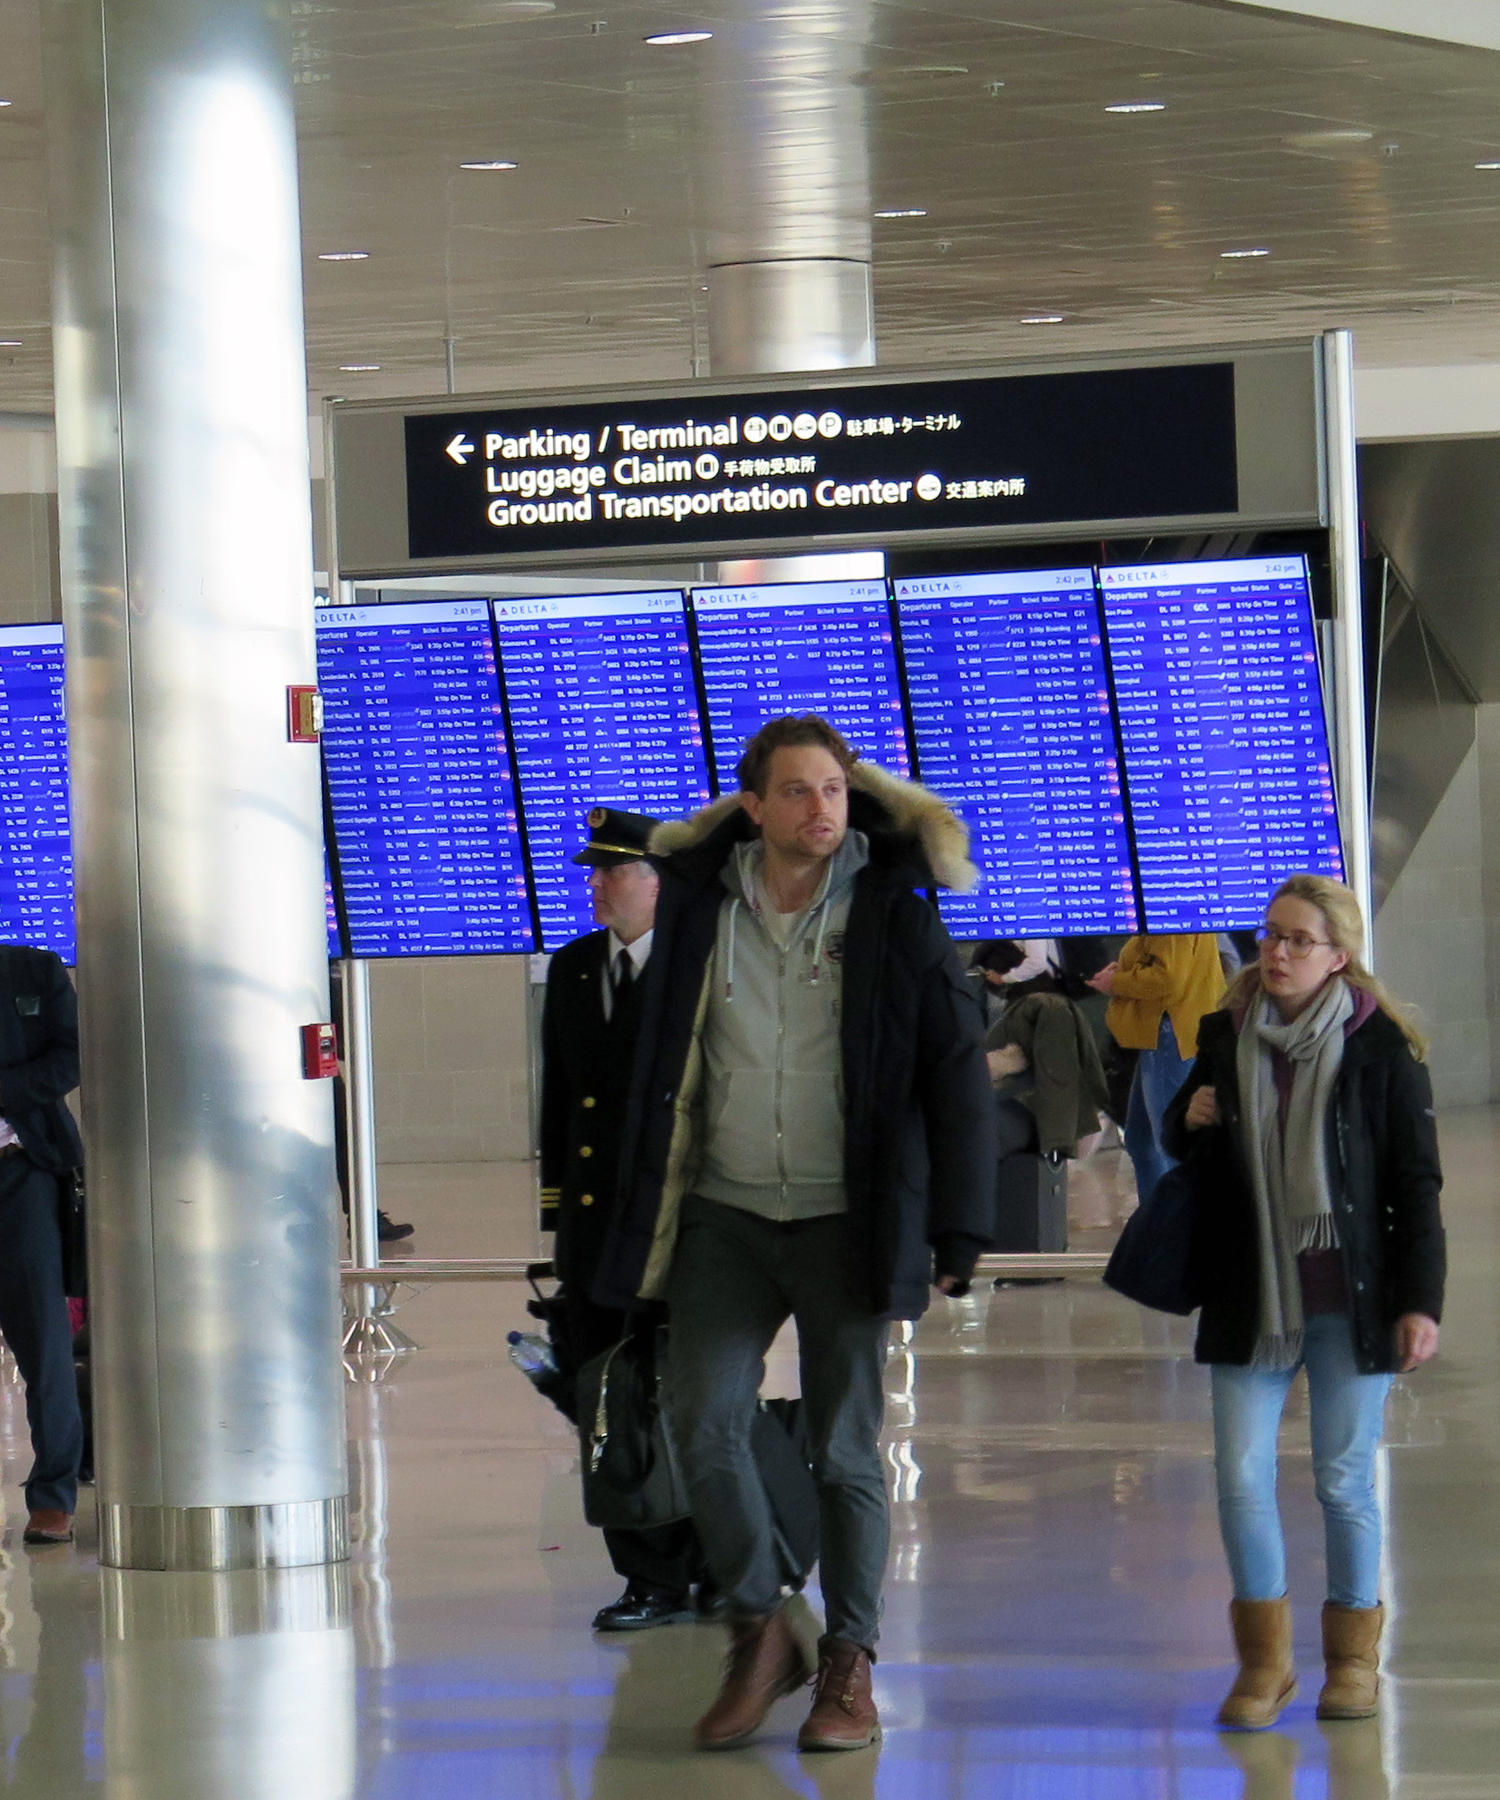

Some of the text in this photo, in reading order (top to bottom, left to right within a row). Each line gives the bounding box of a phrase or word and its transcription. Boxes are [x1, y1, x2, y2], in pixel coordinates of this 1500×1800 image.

[846, 413, 961, 438] 駐車場・ターミナル
[485, 429, 591, 461] Parking
[597, 425, 611, 453] /
[616, 415, 738, 452] Terminal
[723, 455, 816, 478] 手荷物受取所
[485, 455, 692, 498] Luggage Claim
[945, 478, 1026, 500] 交通案内所
[487, 479, 912, 526] Ground Transportation Center
[1118, 572, 1157, 582] DELTA
[912, 583, 950, 593] DELTA
[710, 593, 747, 603] DELTA
[1105, 592, 1148, 601] Departures
[511, 605, 547, 614] DELTA
[900, 603, 941, 612] Departures
[321, 613, 356, 622] DELTA
[698, 612, 738, 622] Departures
[500, 624, 539, 633] Departures
